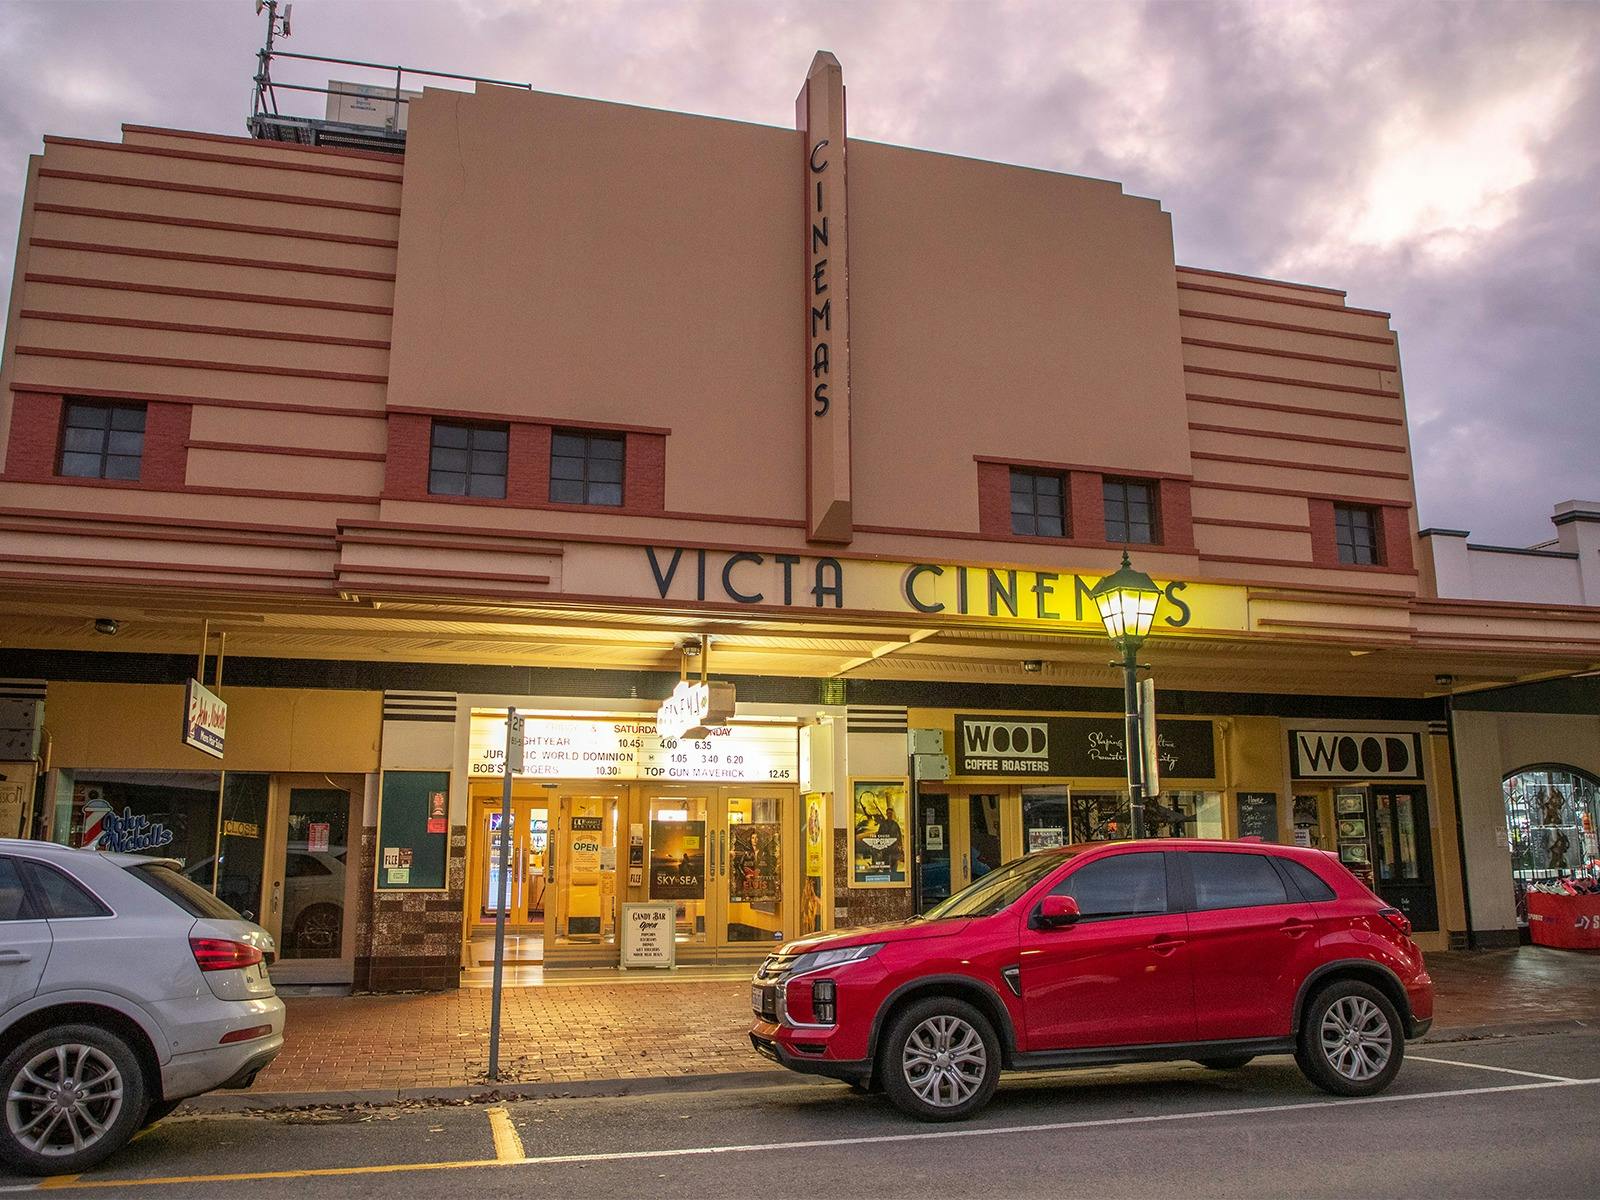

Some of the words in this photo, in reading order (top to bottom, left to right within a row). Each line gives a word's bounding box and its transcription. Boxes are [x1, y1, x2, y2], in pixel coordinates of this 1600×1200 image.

[810, 139, 831, 417] CINEMAS
[645, 546, 843, 608] VICTA
[904, 564, 1191, 627] CINEMS
[512, 716, 525, 732] 2P
[613, 725, 657, 734] SATURDA
[708, 728, 732, 737] NDAY
[522, 736, 571, 746] GHTYEAR
[618, 739, 640, 748] 10.45
[659, 739, 678, 749] 4.00
[694, 741, 712, 750] 6.35
[964, 724, 1049, 754] WOOD
[542, 751, 579, 761] WORLD
[583, 752, 634, 762] DOMINION
[671, 753, 688, 763] 1.05
[1300, 735, 1409, 773] WOOD
[473, 764, 504, 773] BOB'S
[524, 765, 559, 775] RGERS
[596, 766, 618, 775] 10.30
[644, 767, 665, 776] TOP
[668, 767, 690, 777] GUN
[692, 768, 745, 778] MAVERICK
[768, 770, 790, 779] 12.45
[964, 759, 999, 771] COFFEE
[1001, 760, 1049, 772] ROASTERS
[101, 806, 150, 835] John
[98, 823, 174, 853] Nicholls
[573, 842, 599, 852] OPEN
[656, 875, 676, 885] SKY
[680, 875, 698, 885] SEA
[743, 881, 768, 890] ELVIS
[632, 911, 650, 921] CANDY
[652, 911, 666, 921] BAR
